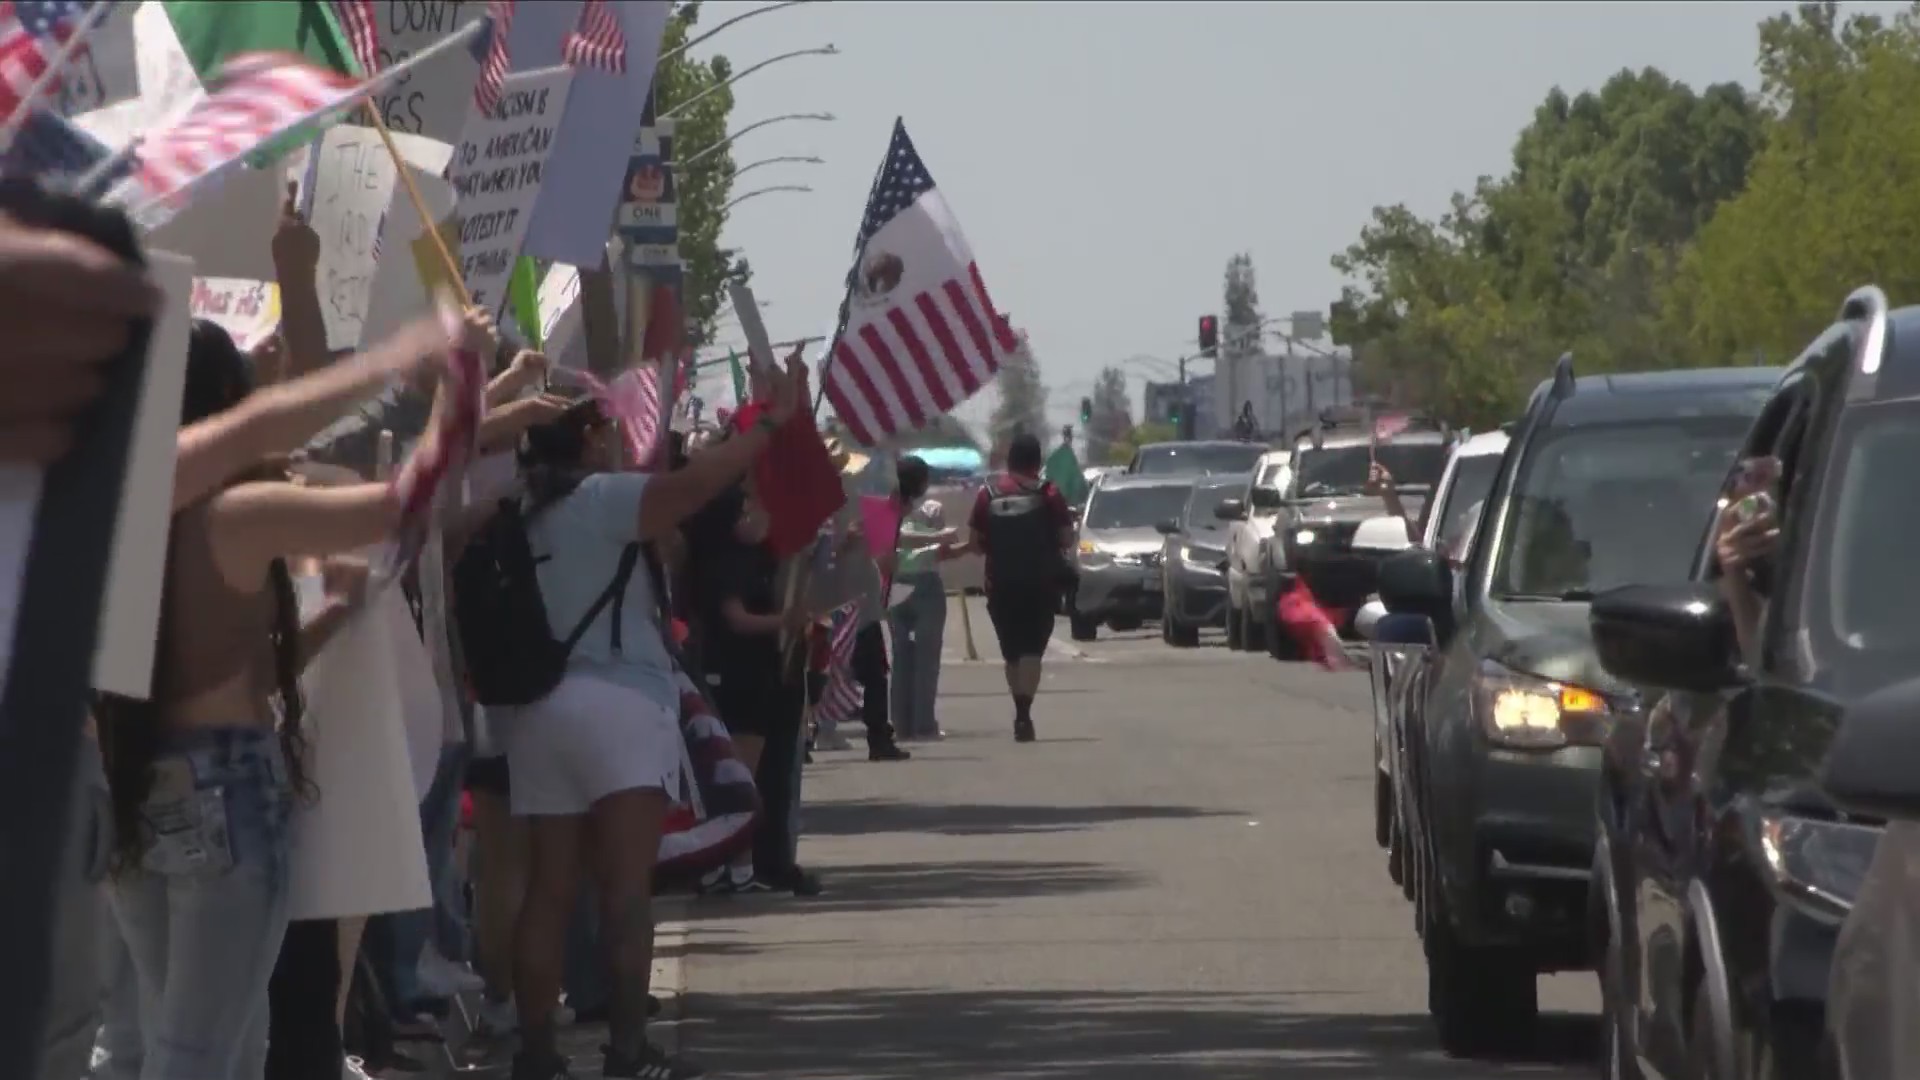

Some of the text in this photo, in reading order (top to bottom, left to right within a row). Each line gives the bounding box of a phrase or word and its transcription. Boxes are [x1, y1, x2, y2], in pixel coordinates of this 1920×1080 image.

[494, 90, 537, 120] ACISM
[484, 124, 553, 159] AMERICAN
[518, 160, 542, 190] YOU
